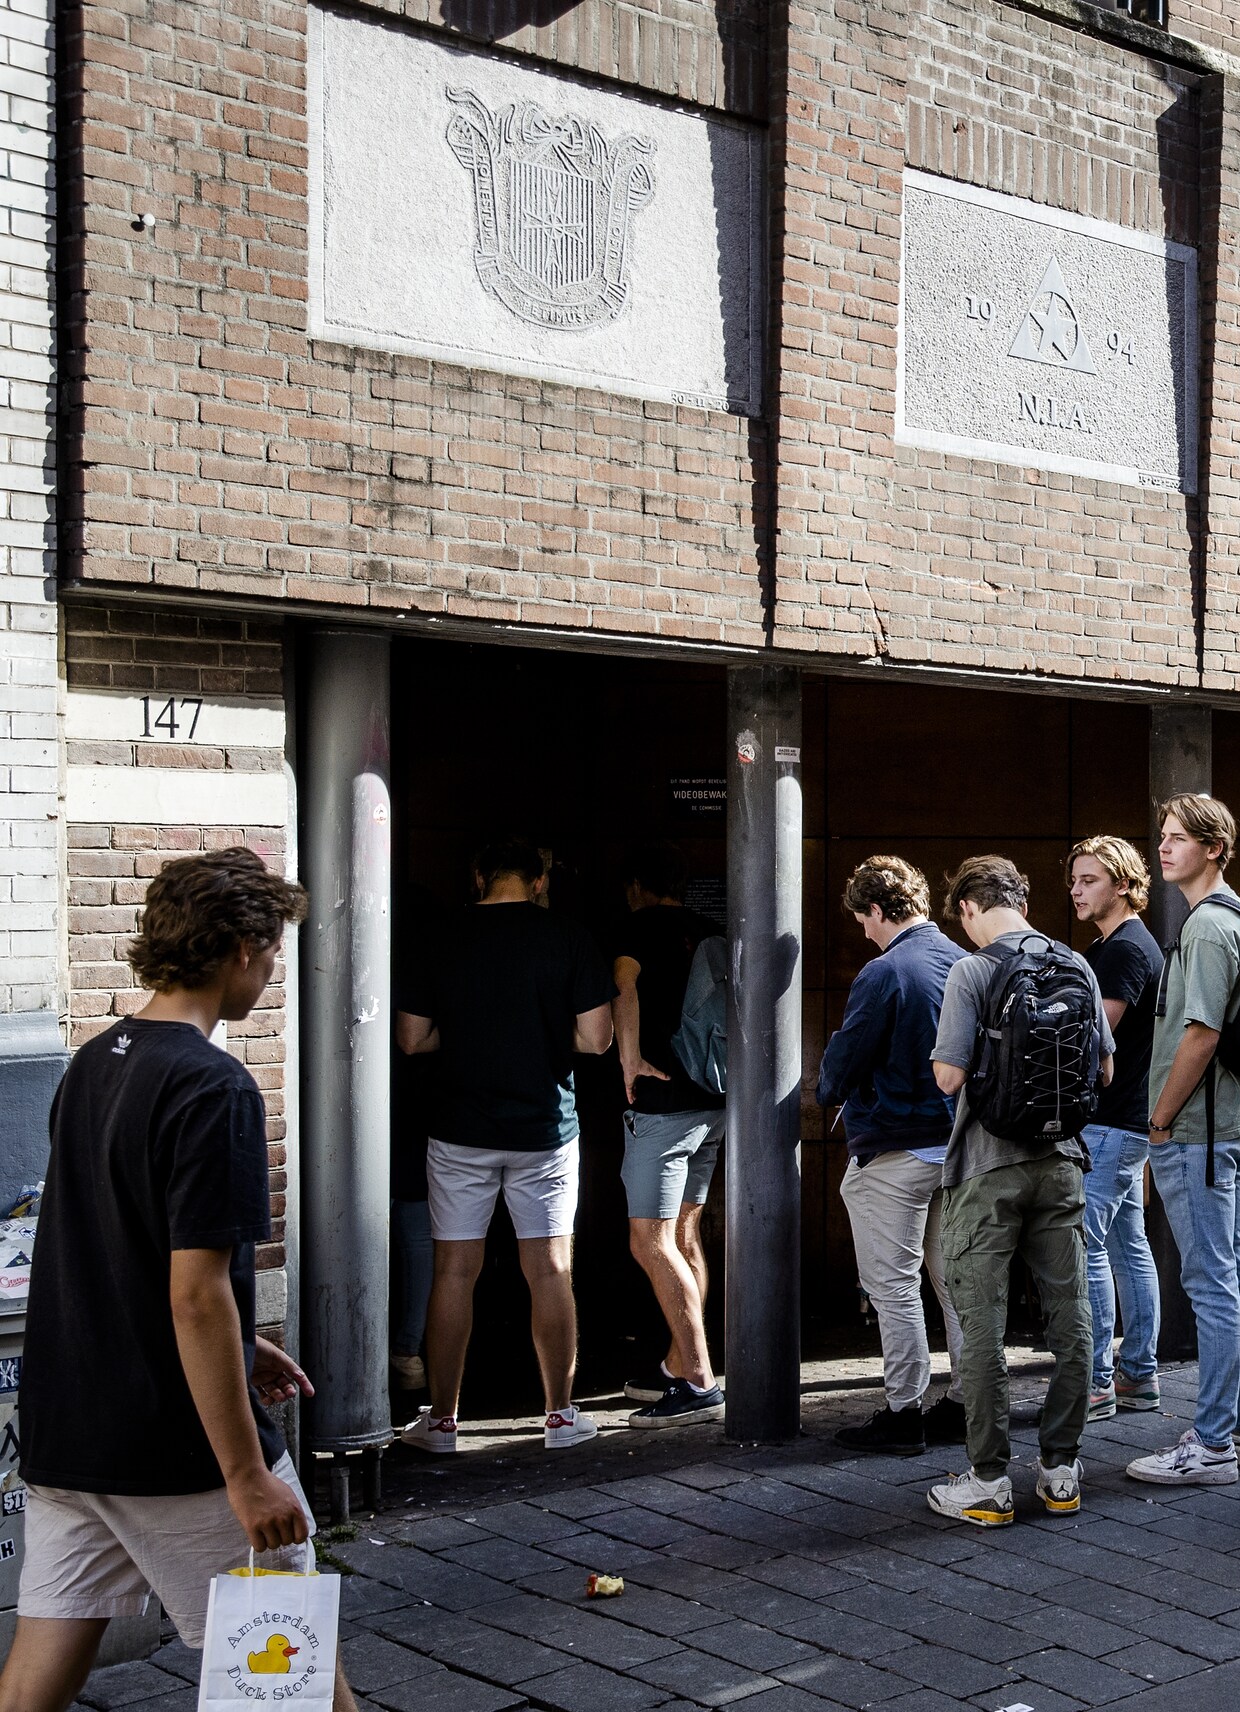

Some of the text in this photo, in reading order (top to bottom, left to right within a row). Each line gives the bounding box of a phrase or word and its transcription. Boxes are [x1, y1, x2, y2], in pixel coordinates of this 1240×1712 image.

[965, 296, 1134, 365] 19 94
[1018, 391, 1093, 434] N.I.A.
[139, 695, 204, 739] 147
[228, 1611, 320, 1649] Amsterdam
[227, 1665, 317, 1701] Duck Store
